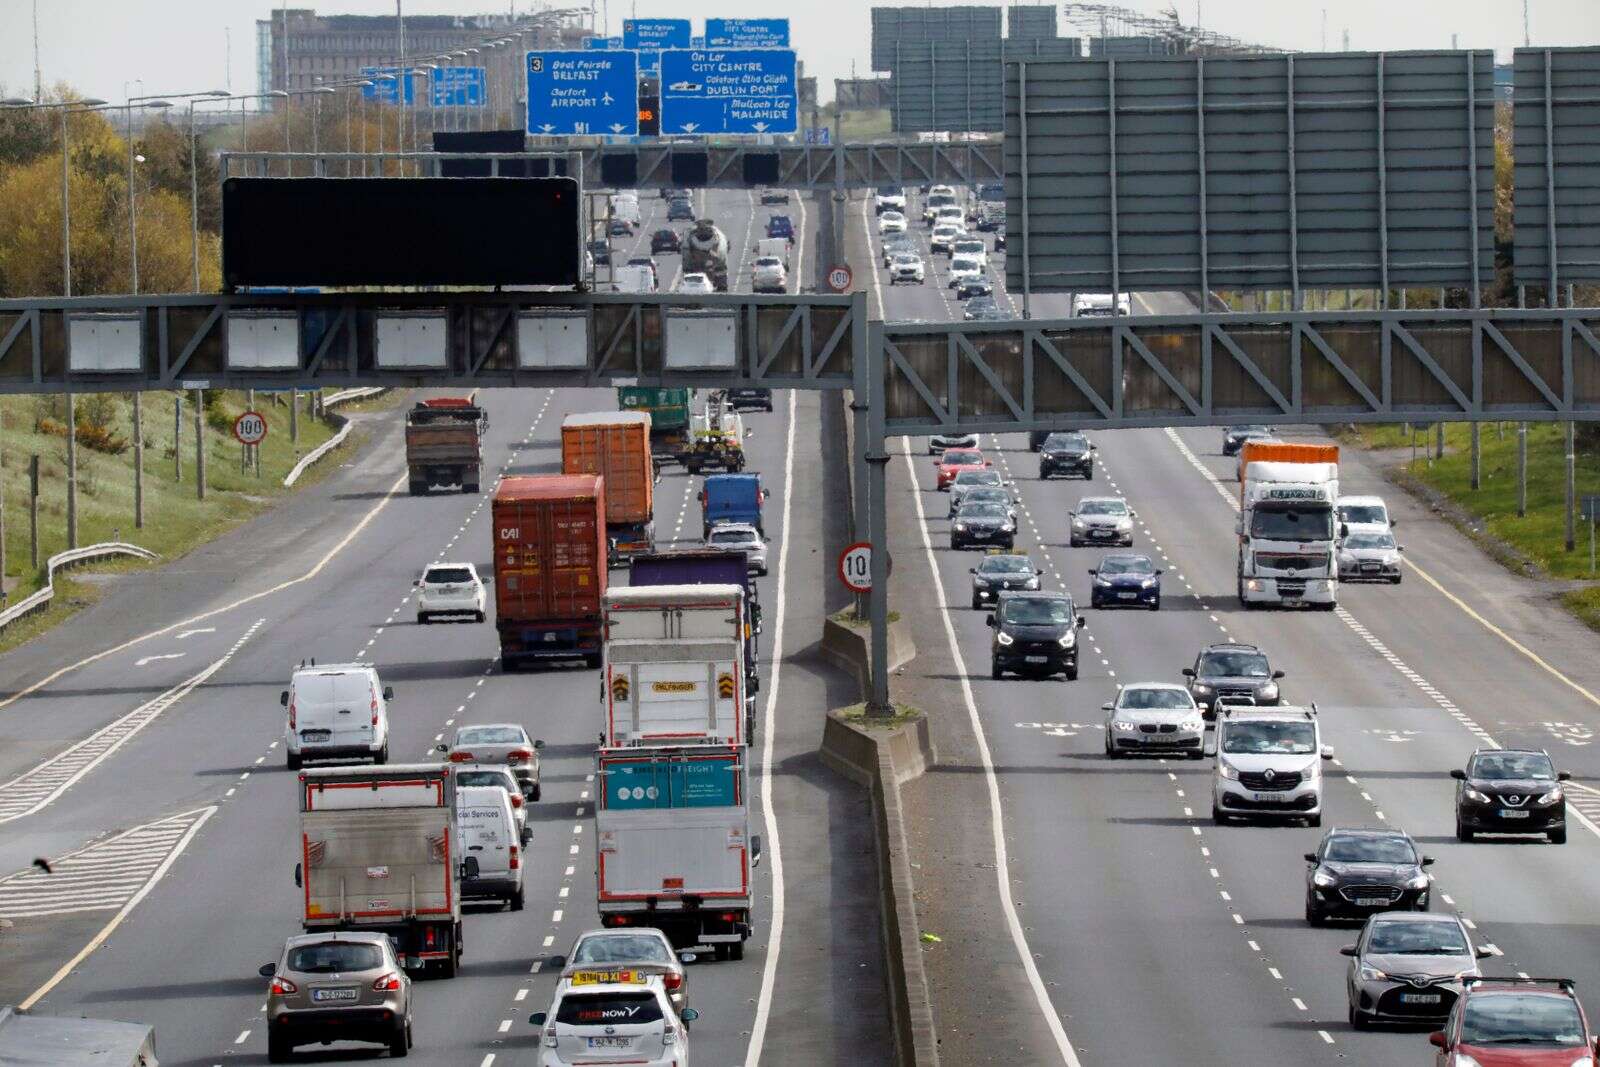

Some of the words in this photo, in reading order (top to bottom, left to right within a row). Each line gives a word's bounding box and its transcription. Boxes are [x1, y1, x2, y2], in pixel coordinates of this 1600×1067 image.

[532, 59, 541, 71] 3
[691, 63, 716, 72] CITY
[718, 62, 763, 73] CENTRE
[552, 70, 600, 81] BELFAST
[706, 85, 747, 95] DUBLIN
[750, 85, 779, 95] PORT
[551, 98, 597, 108] AIRPORT
[731, 110, 789, 120] MALAHIDE
[831, 271, 849, 284] 100
[240, 420, 262, 435] 100
[501, 528, 519, 540] CAI
[846, 555, 867, 576] 10
[677, 764, 714, 774] FEIGHT
[471, 810, 499, 818] Services
